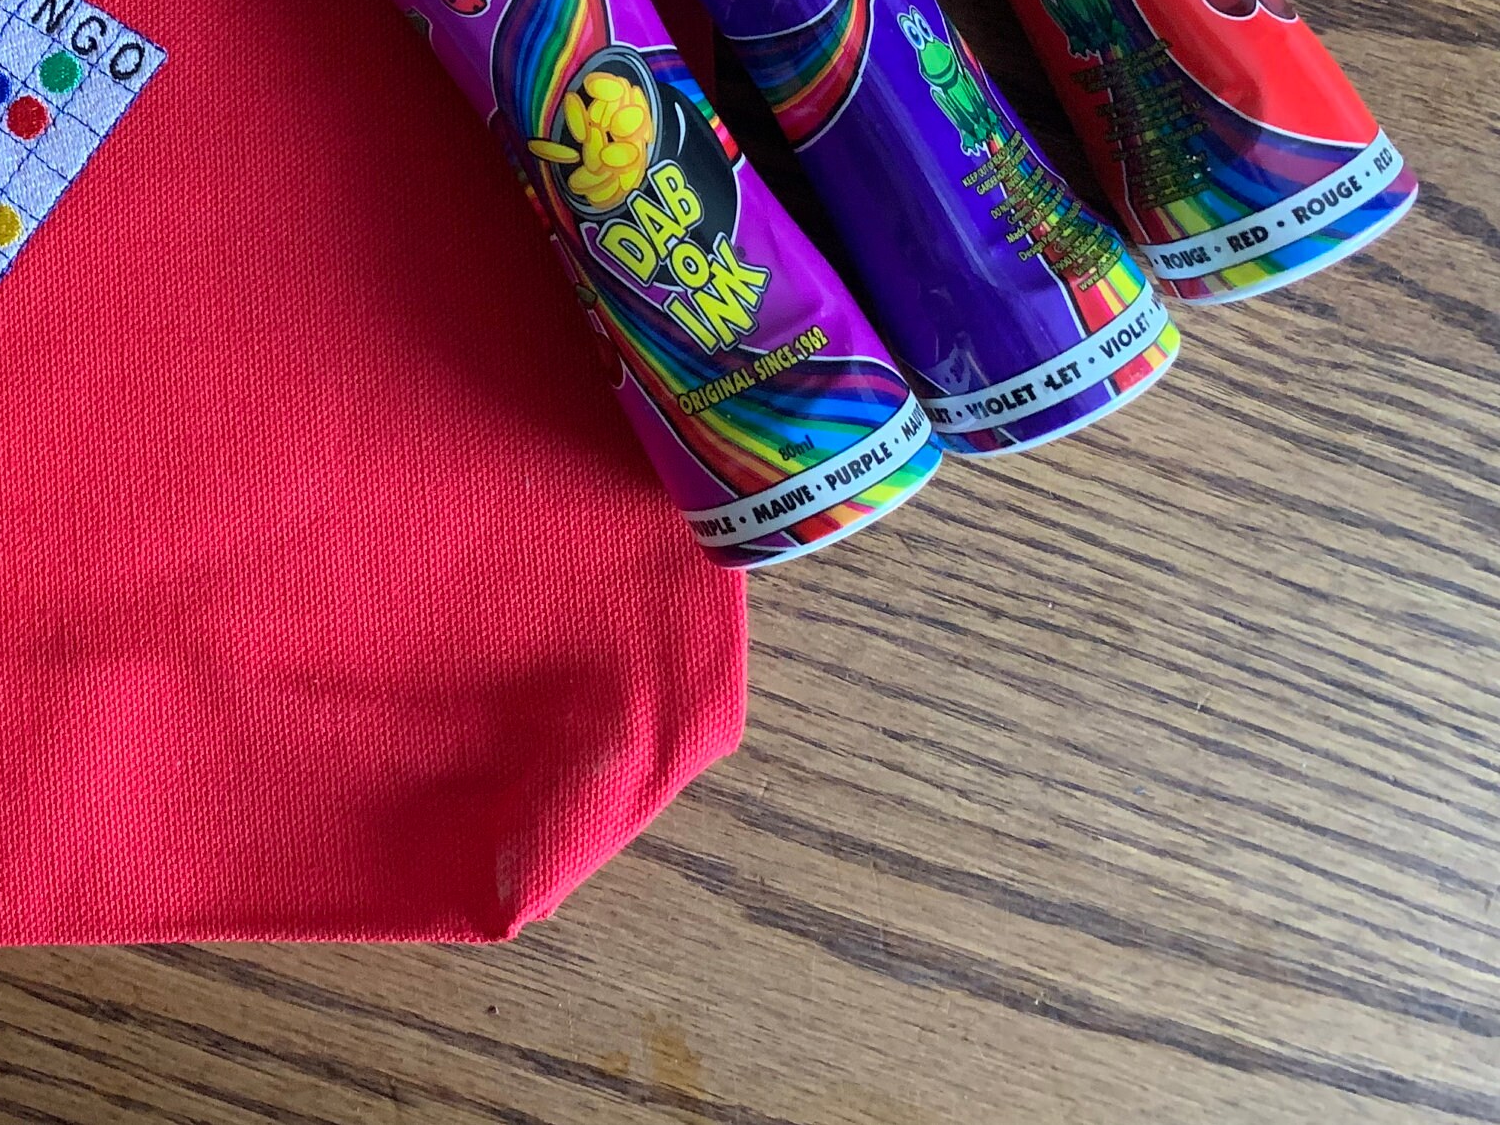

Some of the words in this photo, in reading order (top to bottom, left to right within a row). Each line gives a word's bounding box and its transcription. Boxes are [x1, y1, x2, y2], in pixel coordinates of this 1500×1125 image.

[600, 165, 702, 281] DAB
[1161, 246, 1211, 270] ROUGE
[1226, 224, 1269, 253] RED
[1291, 175, 1362, 225] ROUGE
[1373, 146, 1394, 175] RED
[665, 237, 771, 353] INK
[678, 367, 756, 416] ORIGINAL
[753, 345, 798, 382] SINCE
[794, 326, 829, 361] 1962
[966, 384, 1035, 420] VIOLET
[1100, 313, 1150, 359] VIOLET
[751, 485, 816, 525] MAUVE
[823, 441, 893, 491] PURPLE
[779, 434, 815, 461] 80ml
